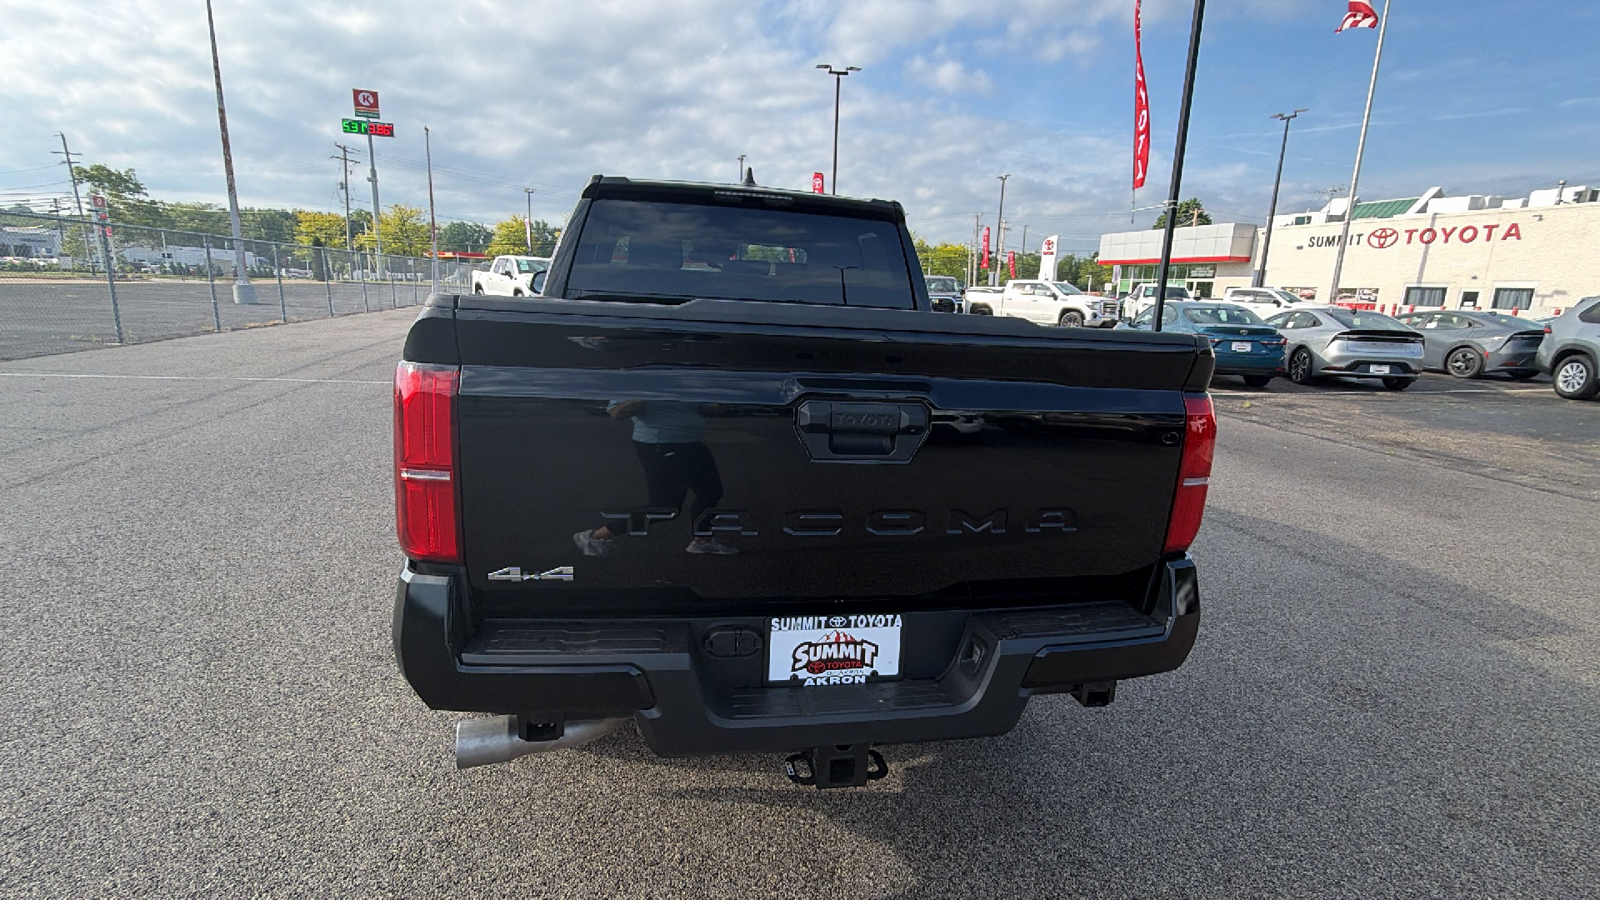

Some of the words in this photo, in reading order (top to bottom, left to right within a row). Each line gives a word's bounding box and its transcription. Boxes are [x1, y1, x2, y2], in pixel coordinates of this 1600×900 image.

[1404, 222, 1522, 245] TOYOTA
[836, 413, 894, 426] TOYOTA
[599, 506, 1079, 536] TACOMA
[771, 616, 828, 631] SUMMIT
[848, 614, 903, 628] TOYOTA
[792, 640, 877, 670] SUMMIT
[826, 661, 862, 669] TOYOTA
[803, 675, 866, 687] AKRON
